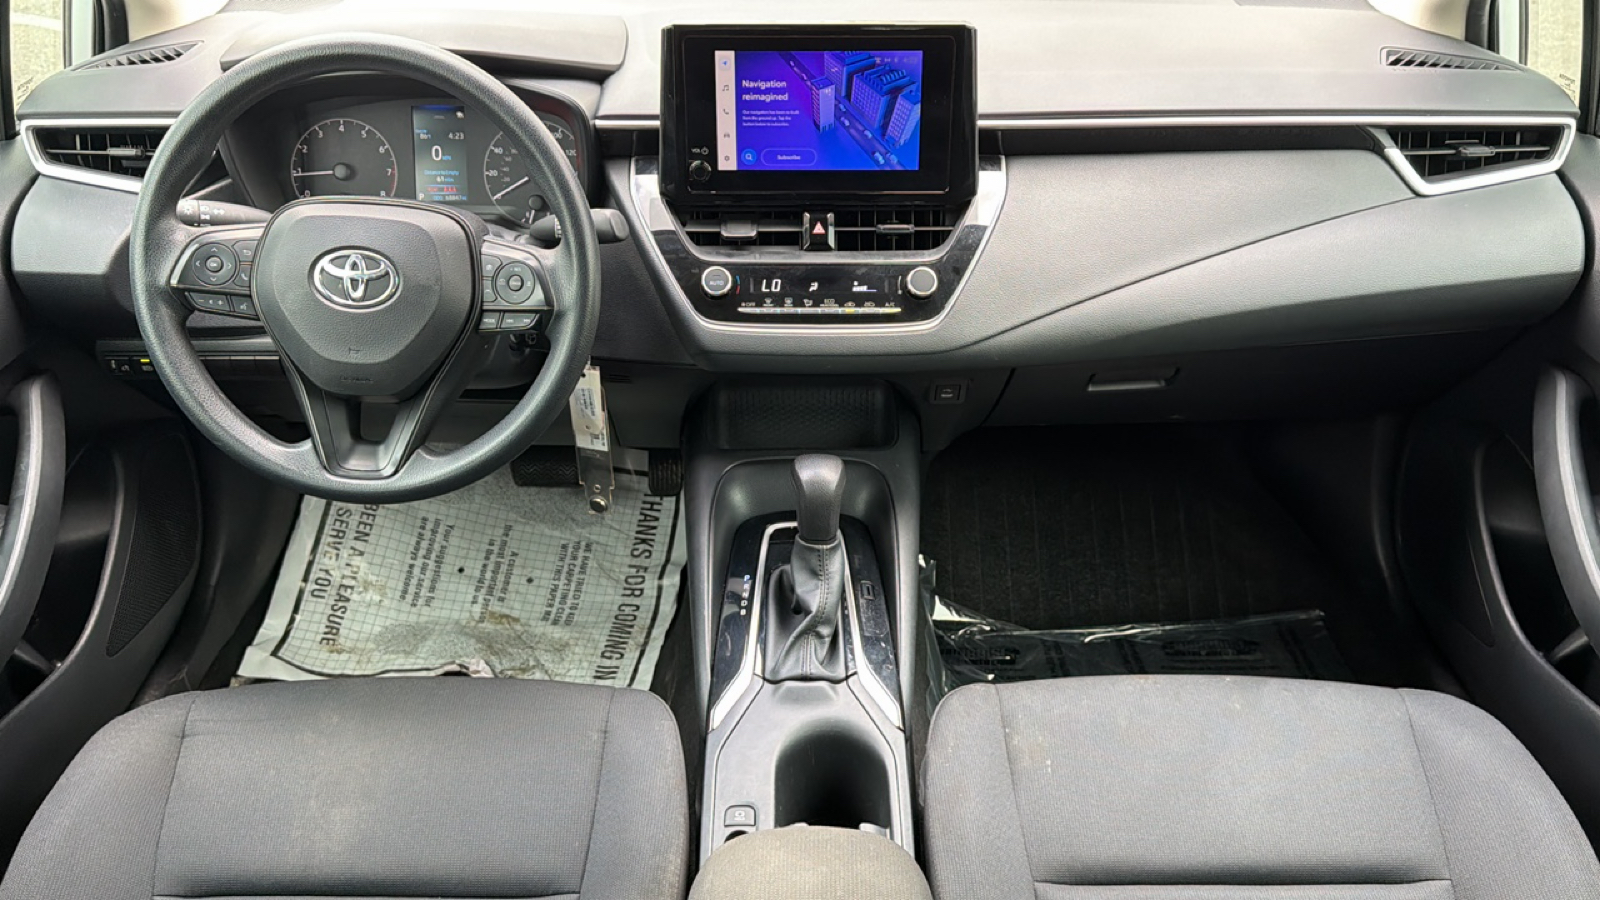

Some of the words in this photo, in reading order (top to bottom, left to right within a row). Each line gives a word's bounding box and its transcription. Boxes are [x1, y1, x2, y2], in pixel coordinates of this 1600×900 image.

[742, 80, 787, 90] Navigation
[742, 92, 789, 102] reimagined
[318, 130, 324, 138] 3
[361, 130, 366, 138] 5
[448, 132, 464, 140] 4:23
[302, 145, 308, 153] 2
[378, 146, 384, 154] 6
[432, 145, 442, 161] 0
[386, 168, 392, 176] 7
[760, 279, 782, 292] LO
[354, 504, 380, 543] BEEN
[420, 516, 429, 530] are
[502, 524, 513, 538] the
[630, 493, 664, 559] THANKS
[324, 507, 352, 562] SERVE
[423, 518, 442, 560] improving
[443, 524, 456, 543] Your
[348, 546, 365, 557] A
[410, 532, 426, 560] always
[484, 549, 494, 561] the
[496, 540, 508, 559] most
[558, 543, 570, 562] WITH
[570, 541, 580, 562] YOUR
[584, 542, 593, 554] WE
[421, 562, 430, 576] our
[428, 545, 448, 594] suggestions
[476, 563, 489, 584] world
[553, 565, 564, 582] THIS
[579, 556, 590, 576] HAVE
[310, 568, 334, 600] YOU
[399, 564, 415, 602] welcome.
[485, 560, 504, 596] important
[500, 558, 516, 595] customer
[559, 563, 576, 606] CARPETING
[621, 564, 650, 598] FOR
[410, 578, 424, 608] service
[546, 584, 560, 608] PAPER
[573, 577, 585, 600] TRIED
[319, 563, 362, 646] PLEASURE
[424, 596, 435, 608] for
[570, 602, 580, 610] TO
[600, 603, 640, 660] COMING
[593, 665, 620, 680] IN
